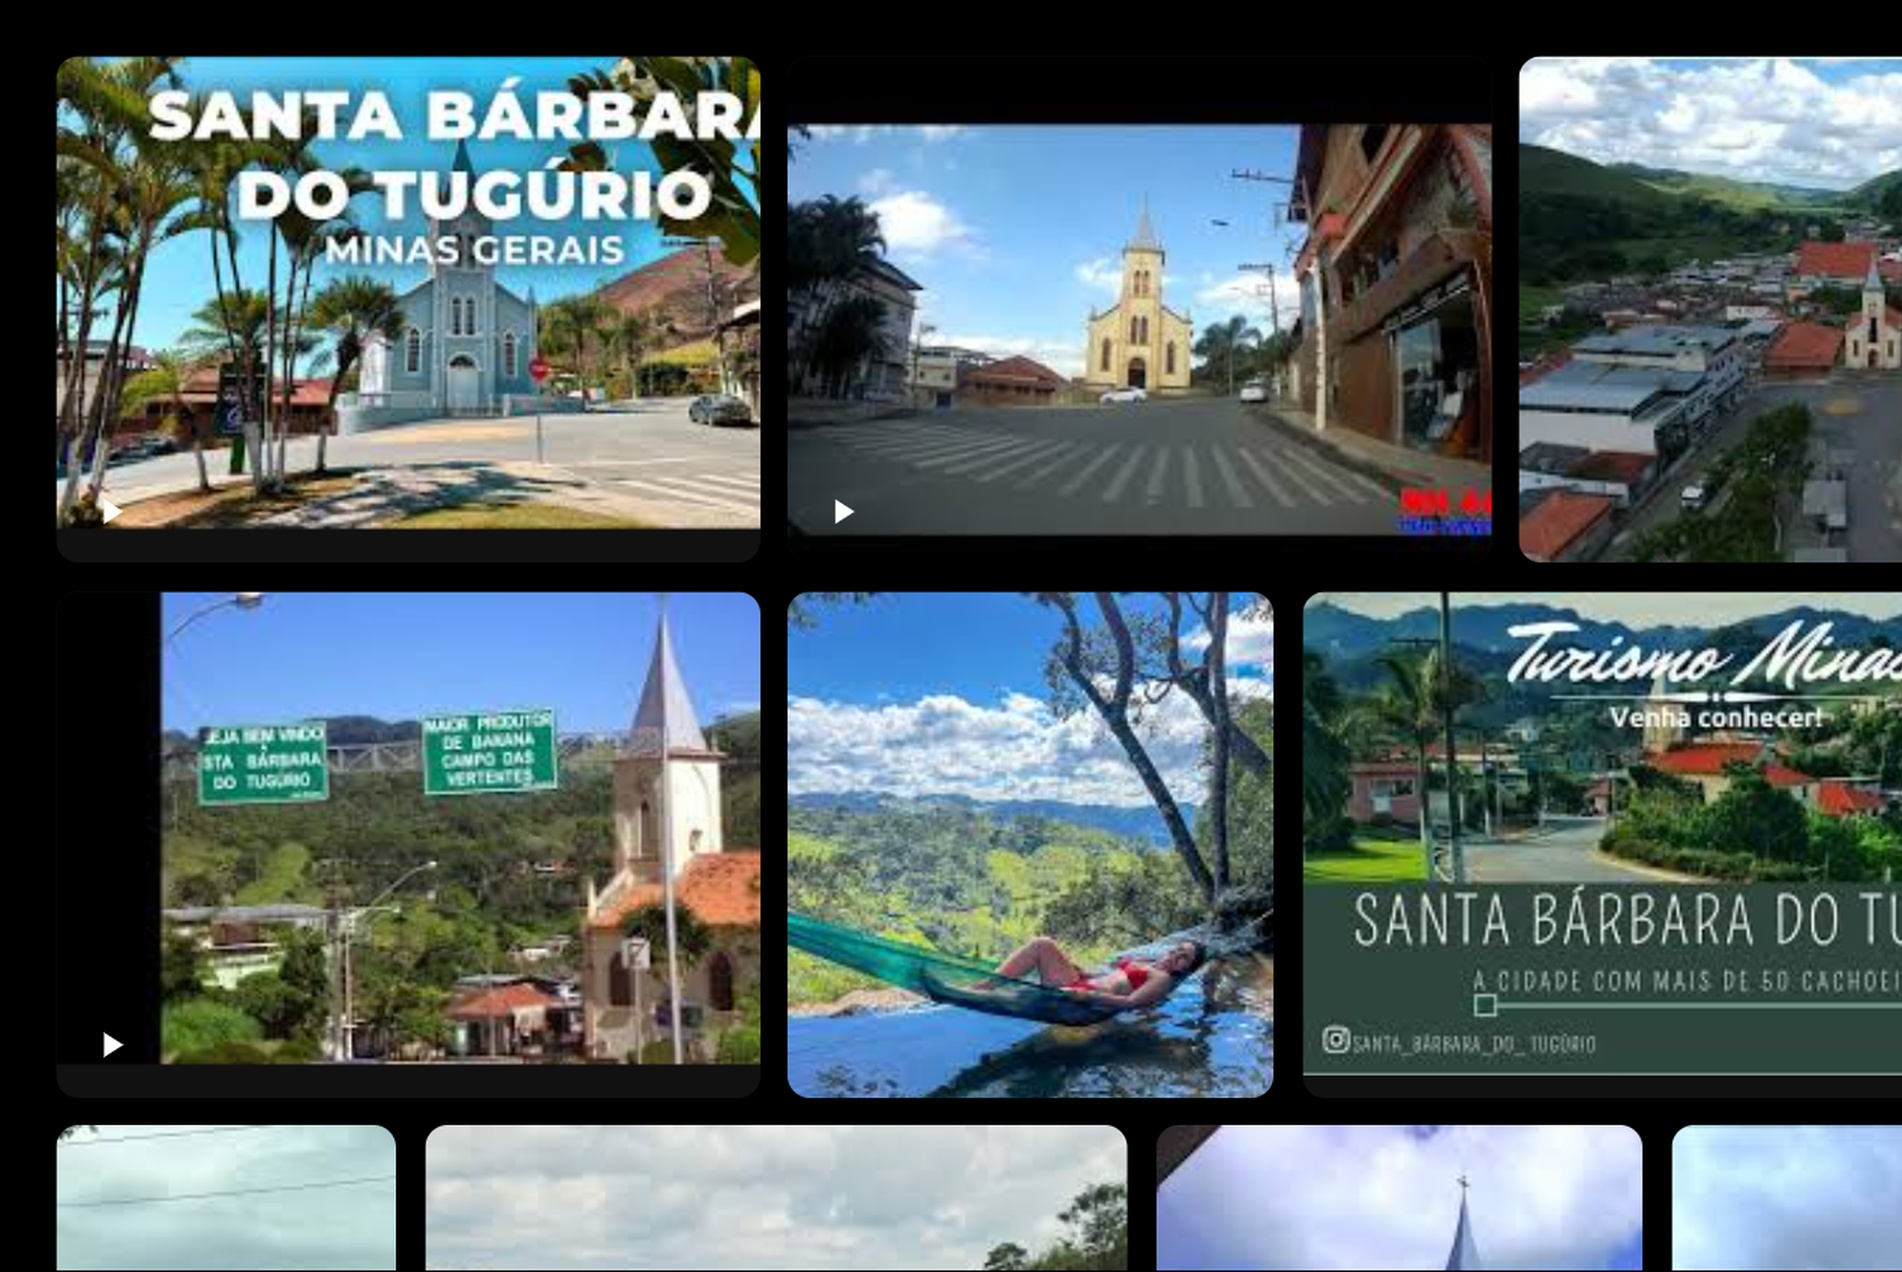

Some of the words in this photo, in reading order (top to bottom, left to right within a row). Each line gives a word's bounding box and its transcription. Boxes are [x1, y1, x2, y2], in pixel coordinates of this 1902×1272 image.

[425, 718, 468, 732] MAIOR
[477, 713, 552, 730] PRODUTOR
[443, 735, 463, 750] DE
[471, 732, 535, 749] BANANA
[203, 754, 234, 770] STA
[246, 751, 322, 769] BÁRBARA
[441, 752, 496, 769] CAMPO
[503, 750, 535, 766] DAS
[213, 775, 237, 790] DO
[446, 769, 534, 786] VERTENTES
